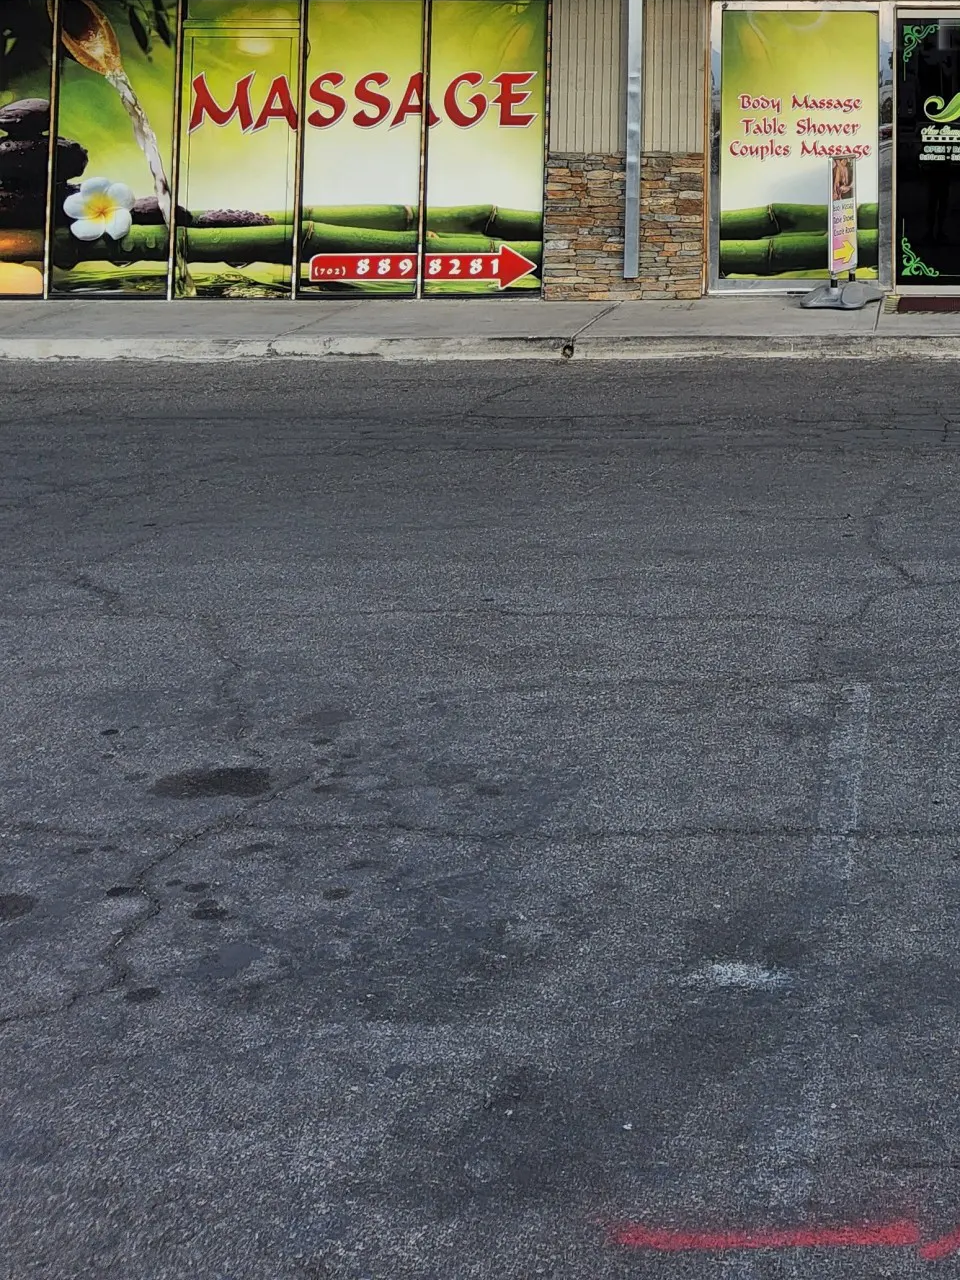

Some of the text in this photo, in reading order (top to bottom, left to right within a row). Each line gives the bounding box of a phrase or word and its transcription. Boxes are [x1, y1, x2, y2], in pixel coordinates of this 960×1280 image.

[188, 71, 538, 134] MASSAGE
[739, 94, 862, 113] Body Massage
[741, 117, 860, 135] Table Shower
[729, 139, 871, 160] Couples Massage
[315, 258, 500, 276] (702) 889 8281
